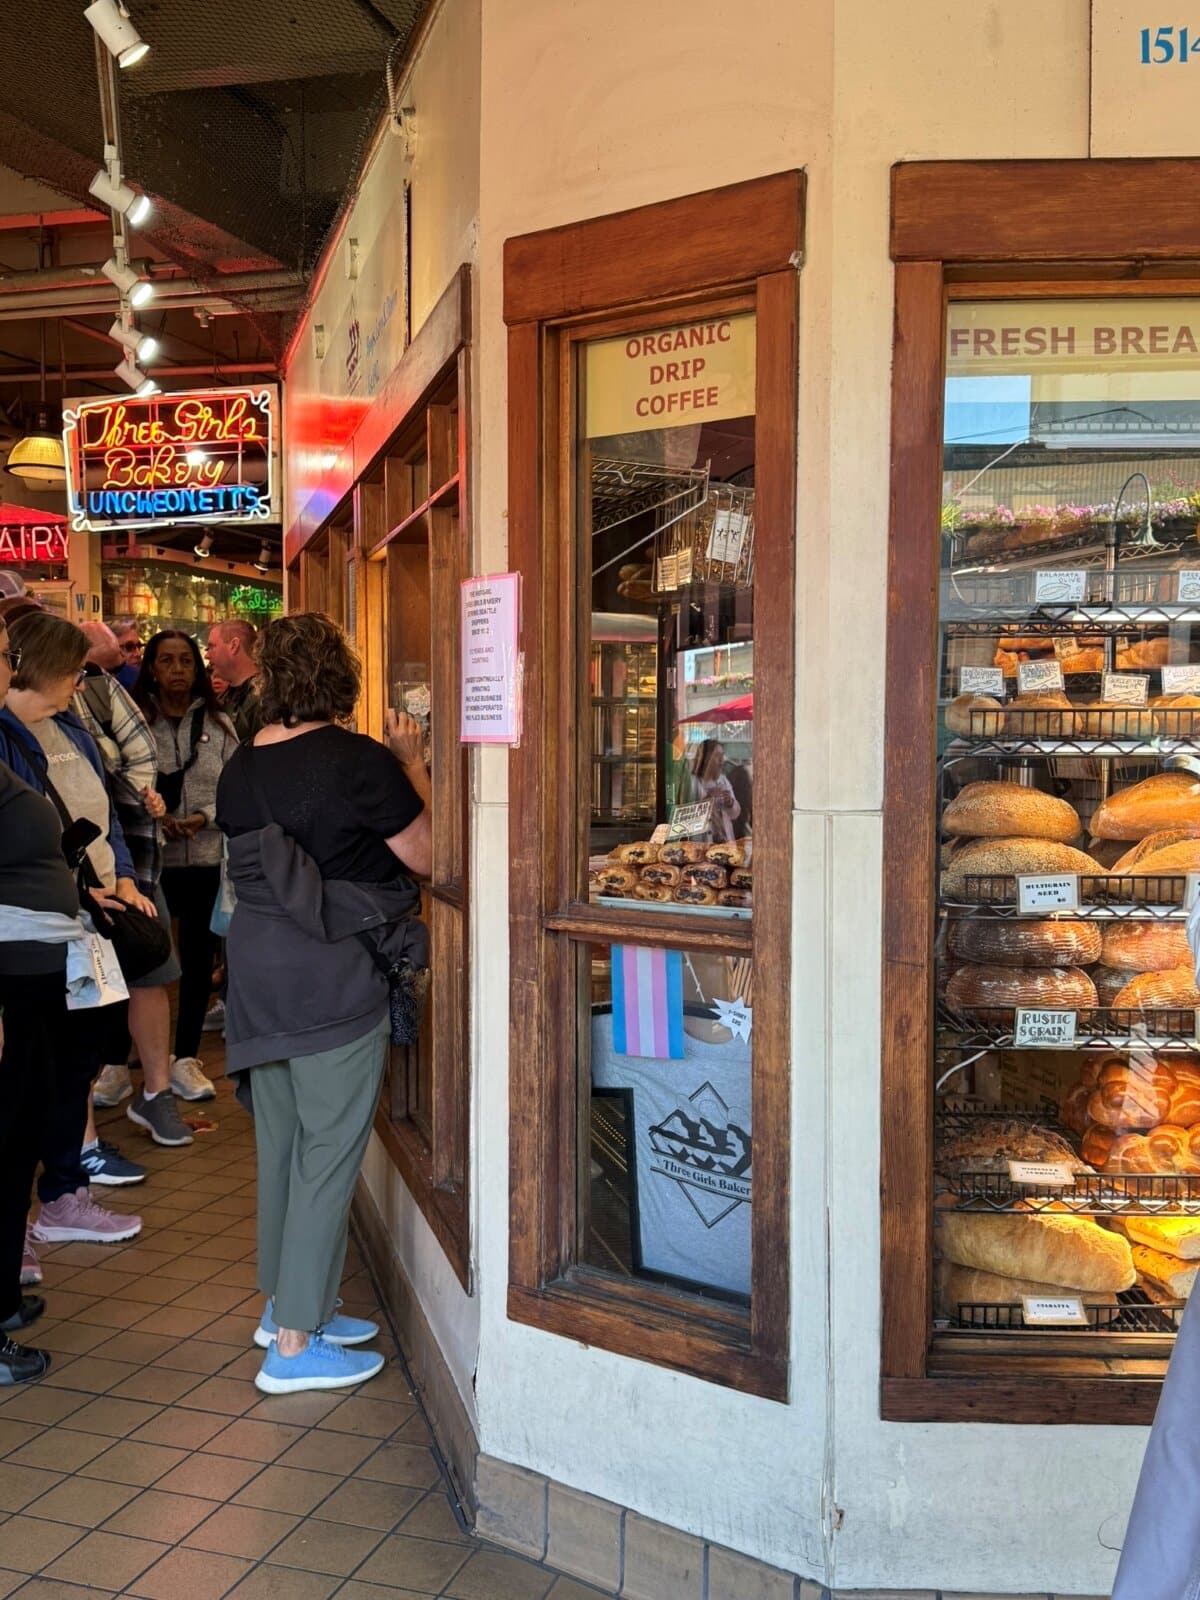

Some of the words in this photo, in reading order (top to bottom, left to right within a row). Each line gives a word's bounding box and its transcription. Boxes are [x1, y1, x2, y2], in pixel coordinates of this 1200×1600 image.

[625, 321, 731, 359] ORGANIC
[950, 327, 1076, 357] FRESH
[1093, 325, 1199, 355] BREA
[649, 357, 706, 385] DRIP
[636, 386, 719, 417] COFFEE
[82, 405, 165, 449] Three
[174, 398, 263, 441] Girls
[103, 444, 225, 489] Bakery
[1025, 882, 1071, 890] MULTIGRAIN
[1021, 1012, 1071, 1025] RUSTIC
[663, 1159, 691, 1178] Three
[692, 1173, 717, 1188] Girls
